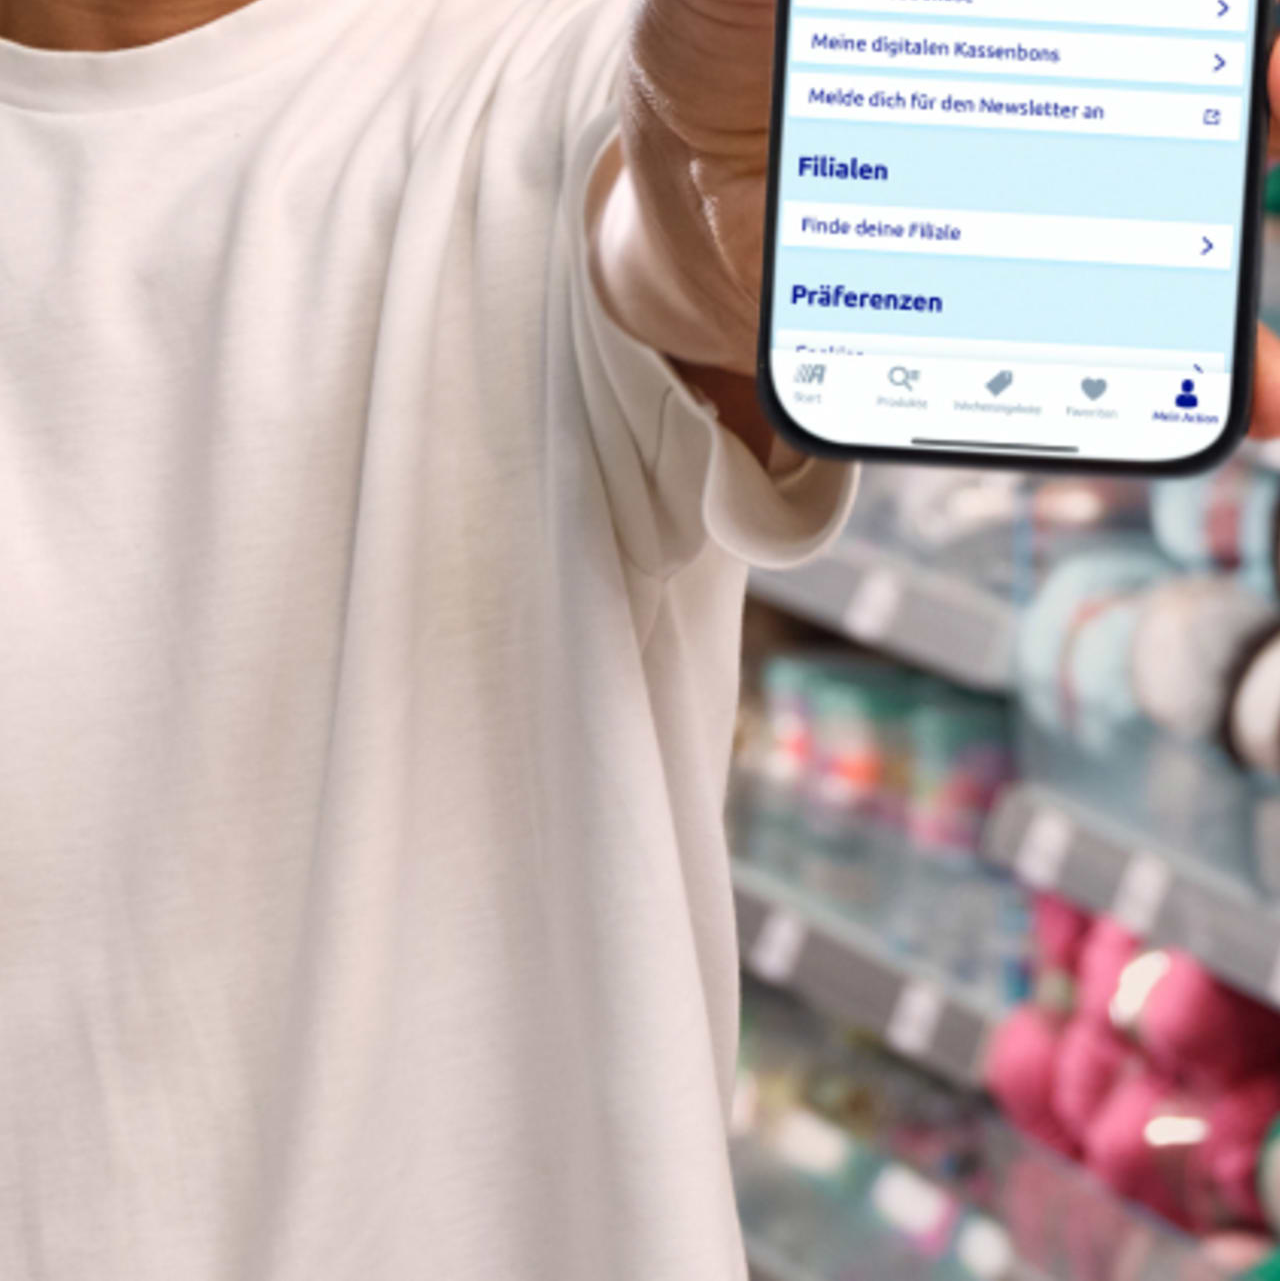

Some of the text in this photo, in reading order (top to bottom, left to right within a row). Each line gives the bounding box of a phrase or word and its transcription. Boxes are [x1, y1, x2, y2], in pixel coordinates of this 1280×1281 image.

[810, 33, 1061, 63] Meine digitalen Kassenbons
[808, 87, 1105, 120] Melde dich für den Newsletter an
[798, 155, 889, 181] Filialen
[801, 216, 962, 241] Finde deine Filiale
[791, 284, 943, 313] Präferenzen
